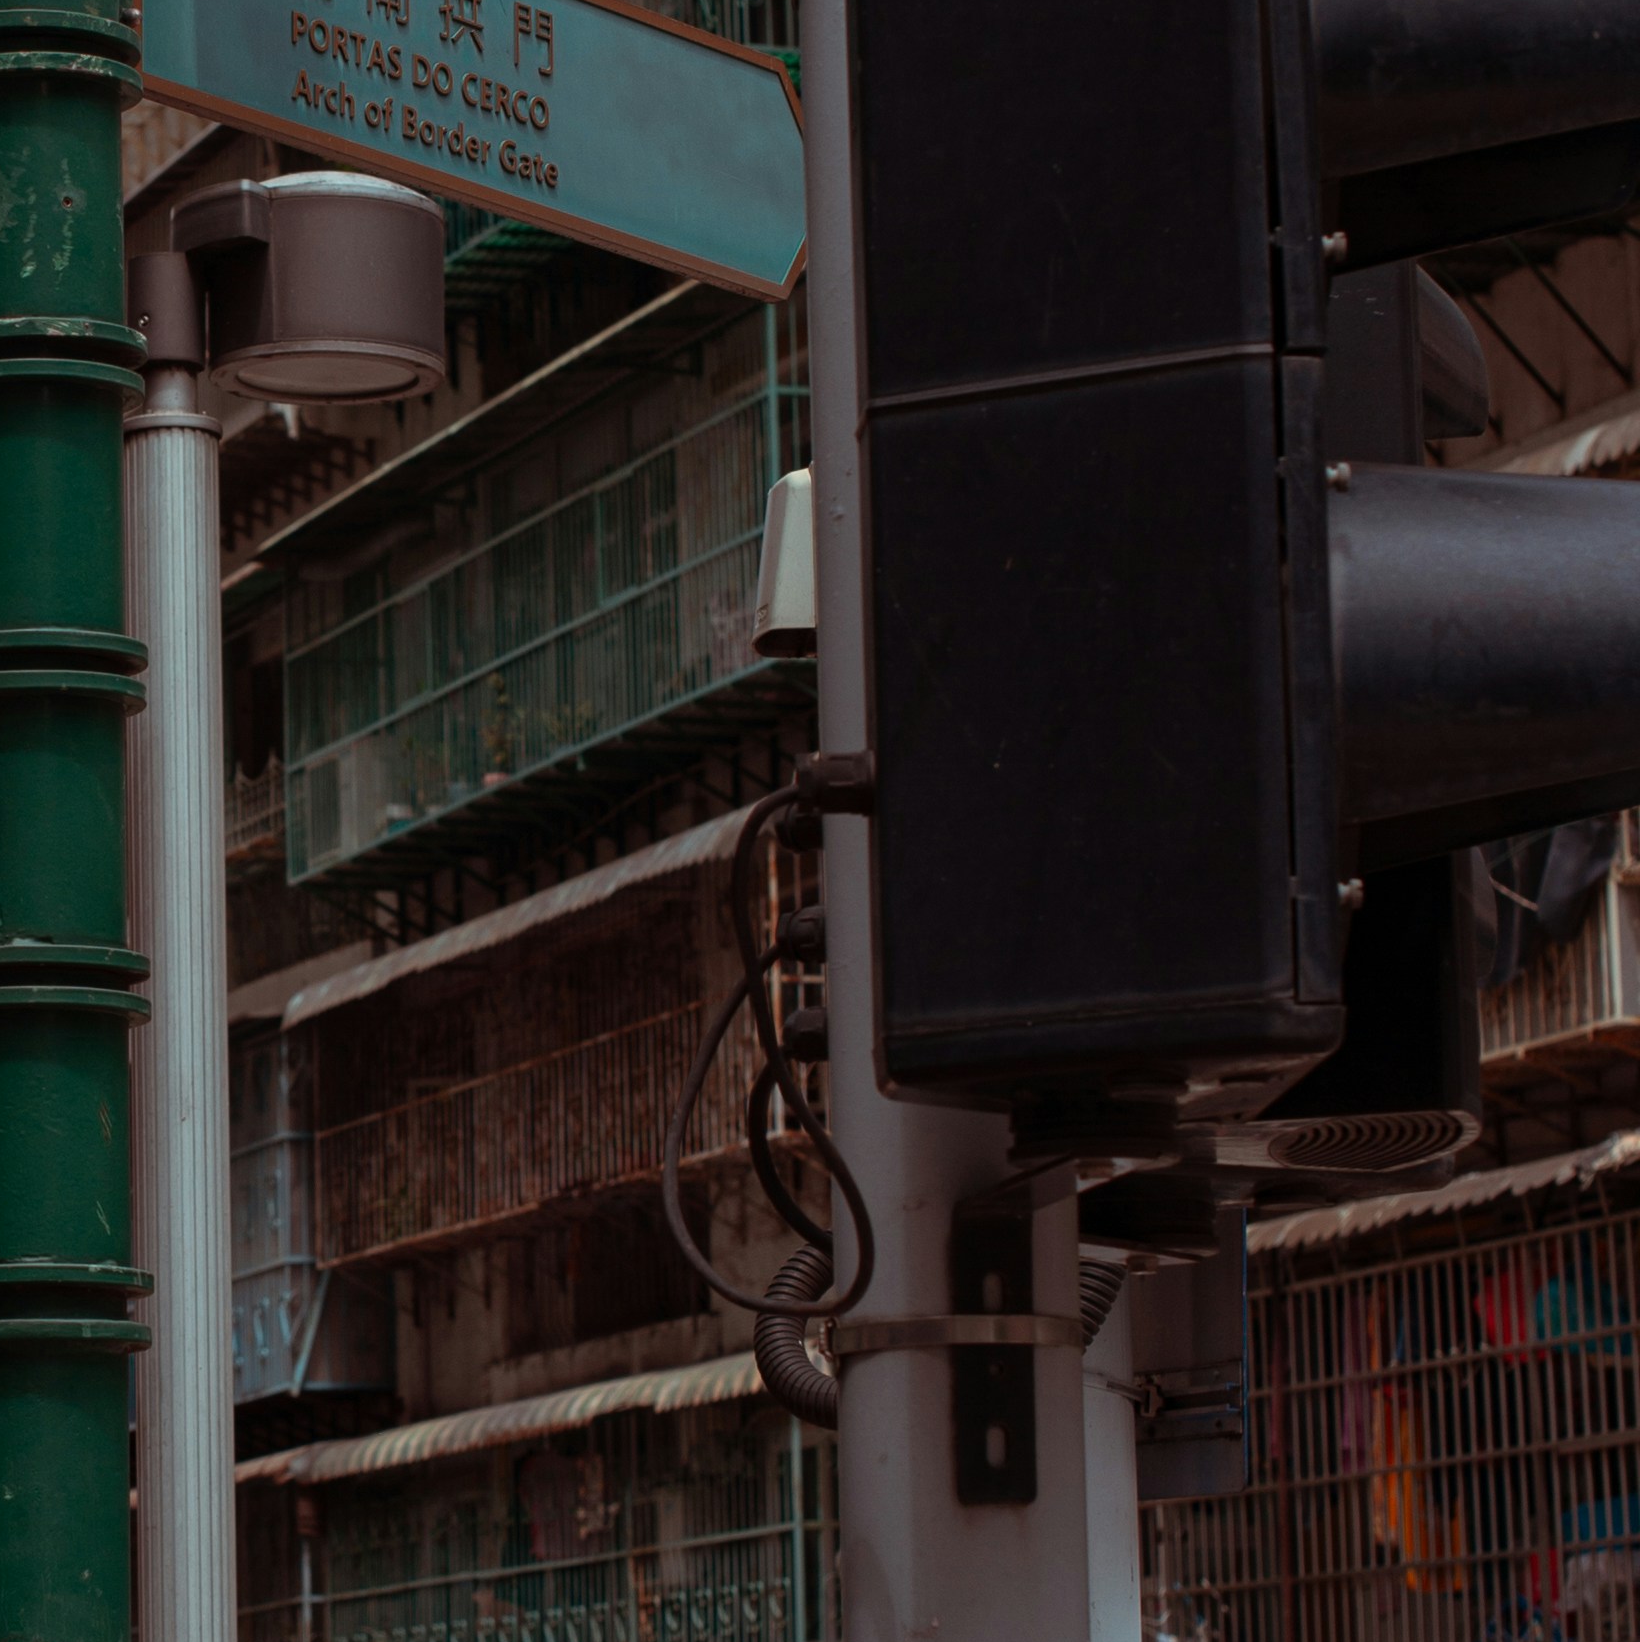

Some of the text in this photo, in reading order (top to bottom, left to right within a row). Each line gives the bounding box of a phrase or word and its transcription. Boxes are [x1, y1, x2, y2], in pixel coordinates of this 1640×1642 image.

[291, 11, 550, 131] PORTAS DO CERCO
[291, 68, 559, 188] Arch of Border Gate
